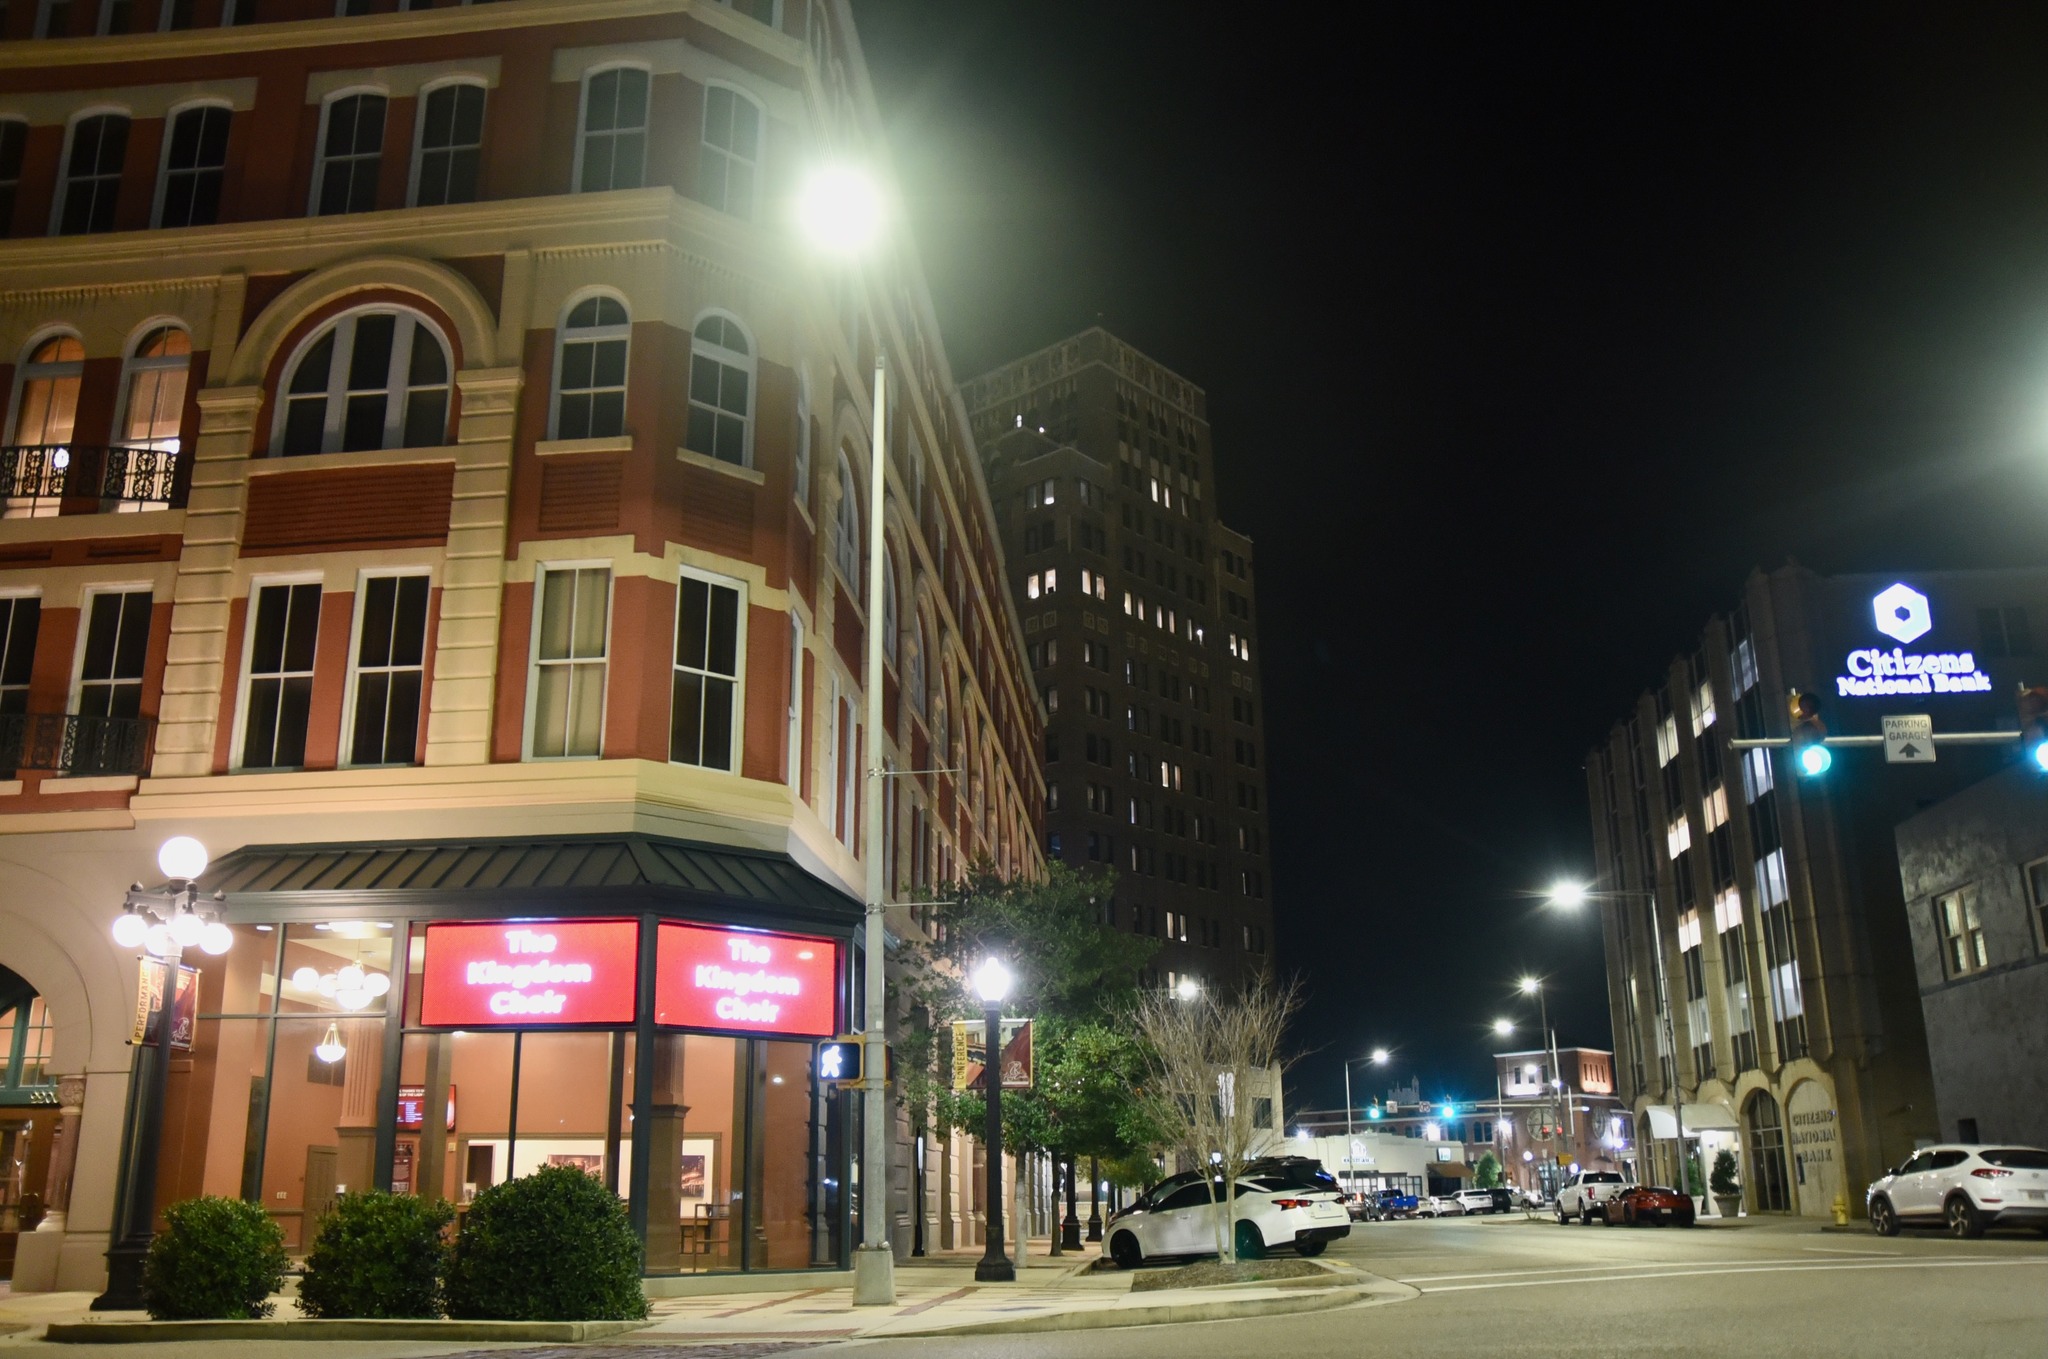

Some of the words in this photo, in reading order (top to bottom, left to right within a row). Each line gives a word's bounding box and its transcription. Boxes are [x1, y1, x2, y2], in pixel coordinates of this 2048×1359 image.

[1847, 647, 1975, 677] Citizens
[1836, 673, 1932, 696] National
[1932, 671, 1992, 693] Bank
[1885, 720, 1928, 729] PARKING
[1889, 731, 1928, 741] GARAGE
[504, 929, 558, 954] The
[727, 938, 772, 965] The
[467, 959, 593, 990] Kingdom
[695, 964, 801, 997] Kingdom
[489, 989, 567, 1015] Choir
[716, 996, 780, 1023] Choir
[955, 1031, 966, 1081] CONFERENCE
[1792, 1128, 1836, 1145] NATIONAL
[1802, 1148, 1833, 1163] BANK
